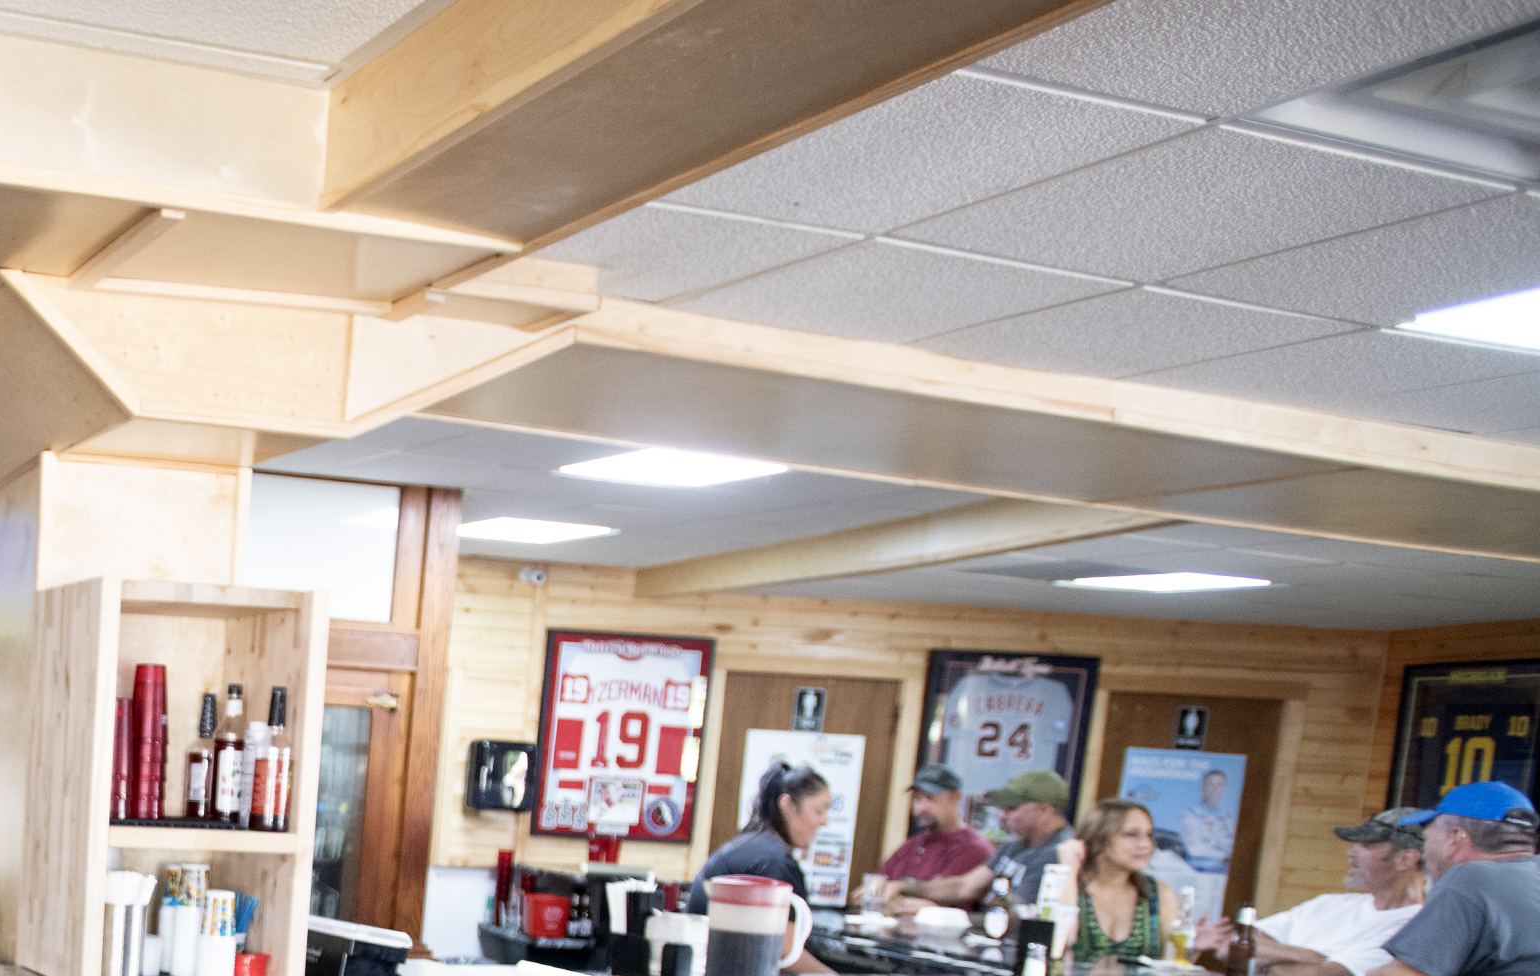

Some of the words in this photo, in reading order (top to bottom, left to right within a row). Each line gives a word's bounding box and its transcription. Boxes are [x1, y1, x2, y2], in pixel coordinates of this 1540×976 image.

[563, 677, 589, 704] 19
[589, 680, 664, 710] YZERMAN
[665, 683, 691, 709] 19
[975, 695, 1044, 716] CABRERA
[591, 711, 650, 769] 19
[976, 720, 1031, 759] 24
[1440, 736, 1495, 796] 10
